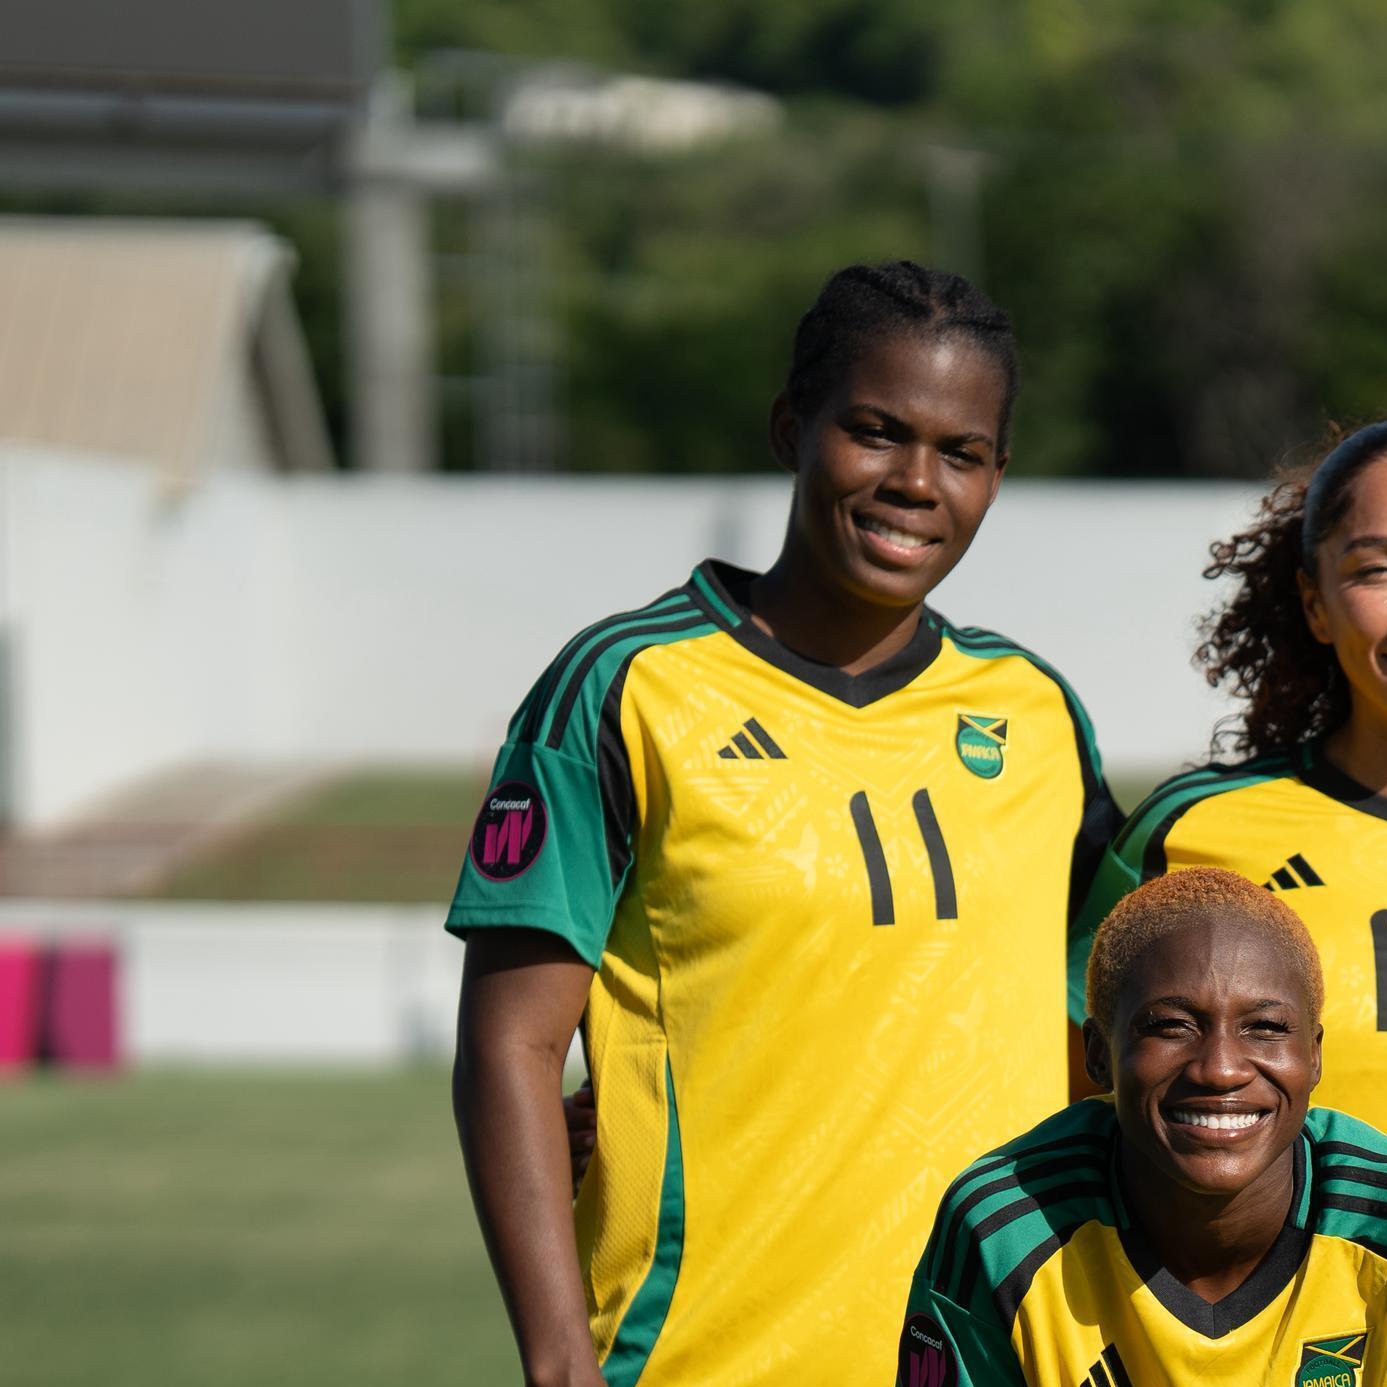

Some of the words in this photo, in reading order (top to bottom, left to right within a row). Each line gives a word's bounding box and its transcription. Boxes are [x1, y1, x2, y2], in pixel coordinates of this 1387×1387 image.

[489, 797, 532, 811] Concacaf
[850, 788, 958, 926] 11
[909, 1324, 944, 1352] Concacaf
